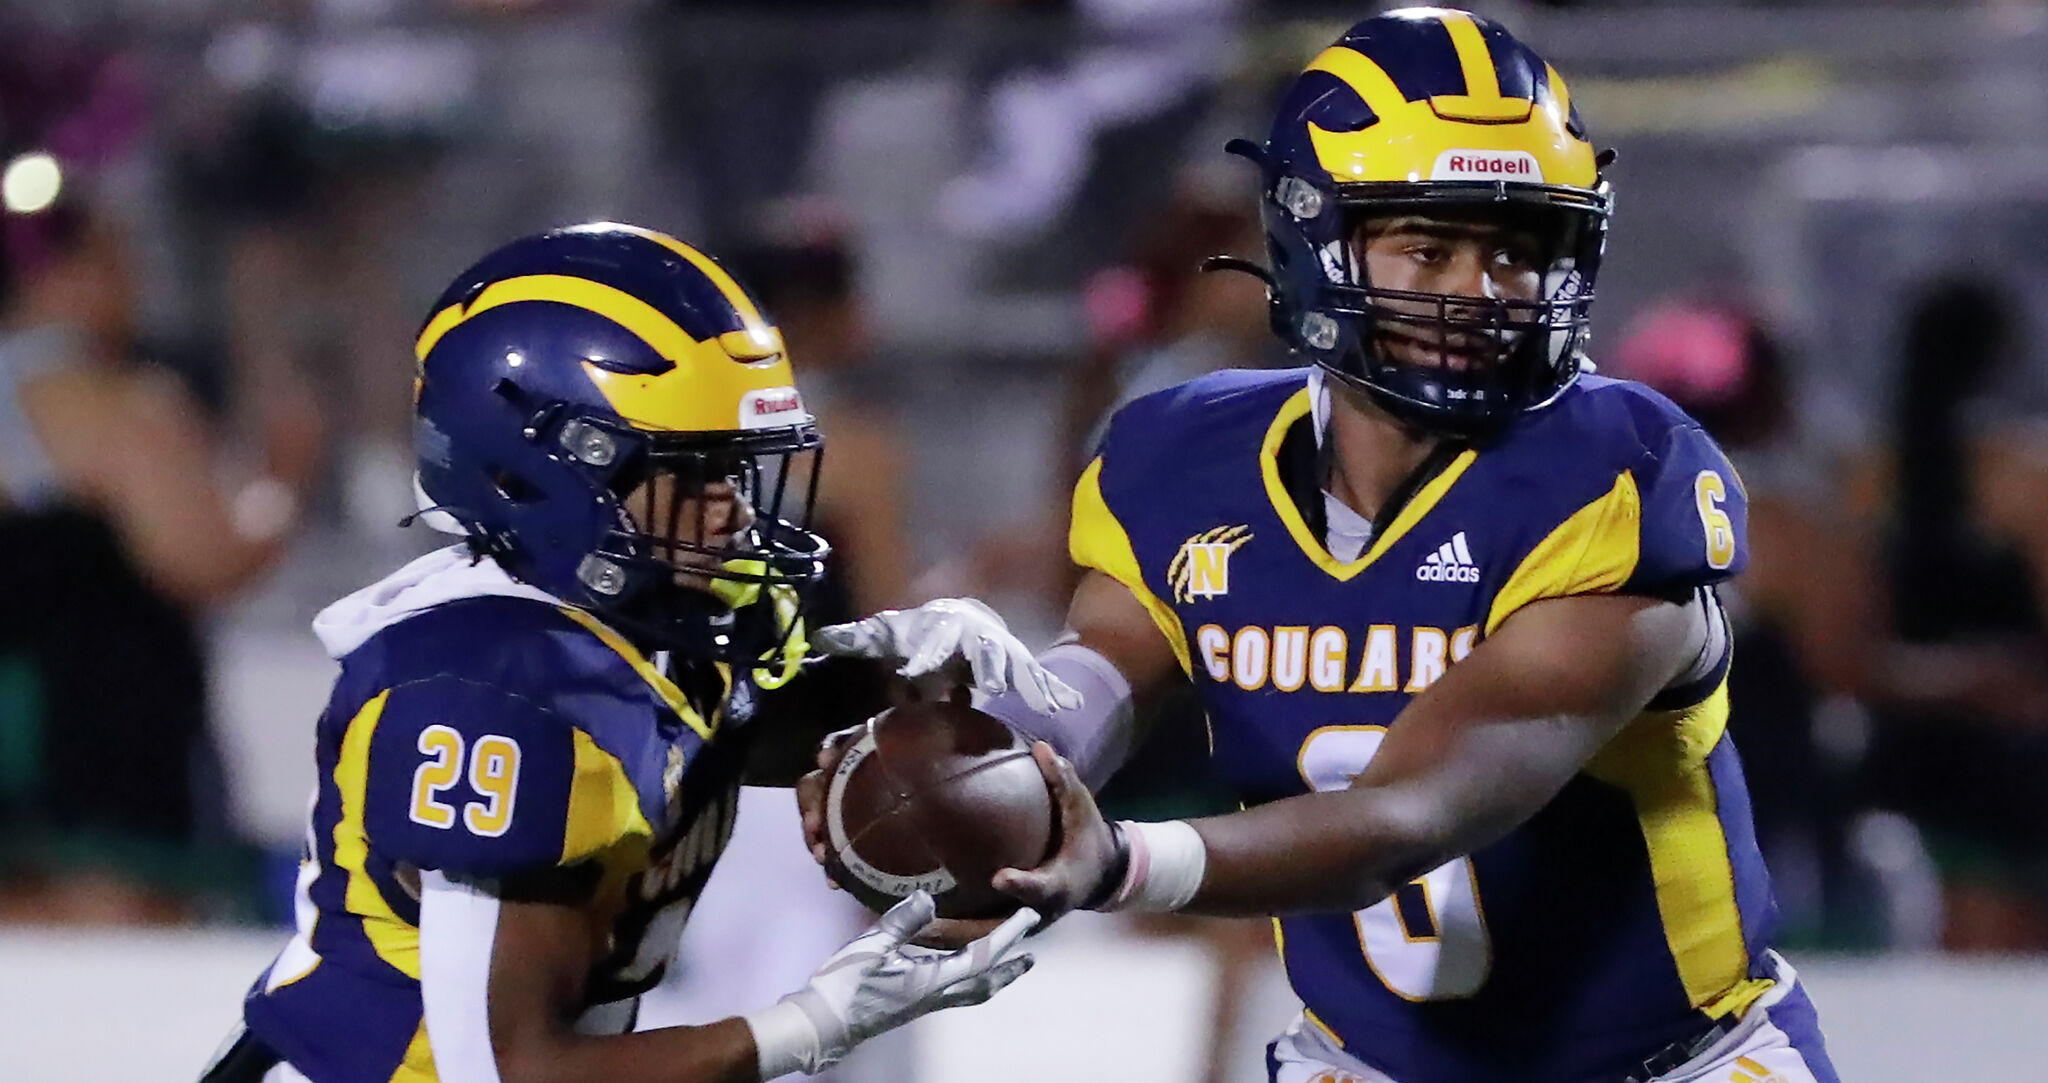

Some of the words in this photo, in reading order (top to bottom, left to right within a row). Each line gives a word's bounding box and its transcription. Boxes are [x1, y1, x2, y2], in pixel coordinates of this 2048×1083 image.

[1450, 156, 1530, 174] Riddell
[1695, 470, 1735, 569] 6
[1188, 543, 1230, 594] N
[1416, 557, 1480, 583] adidas
[409, 724, 521, 837] 29
